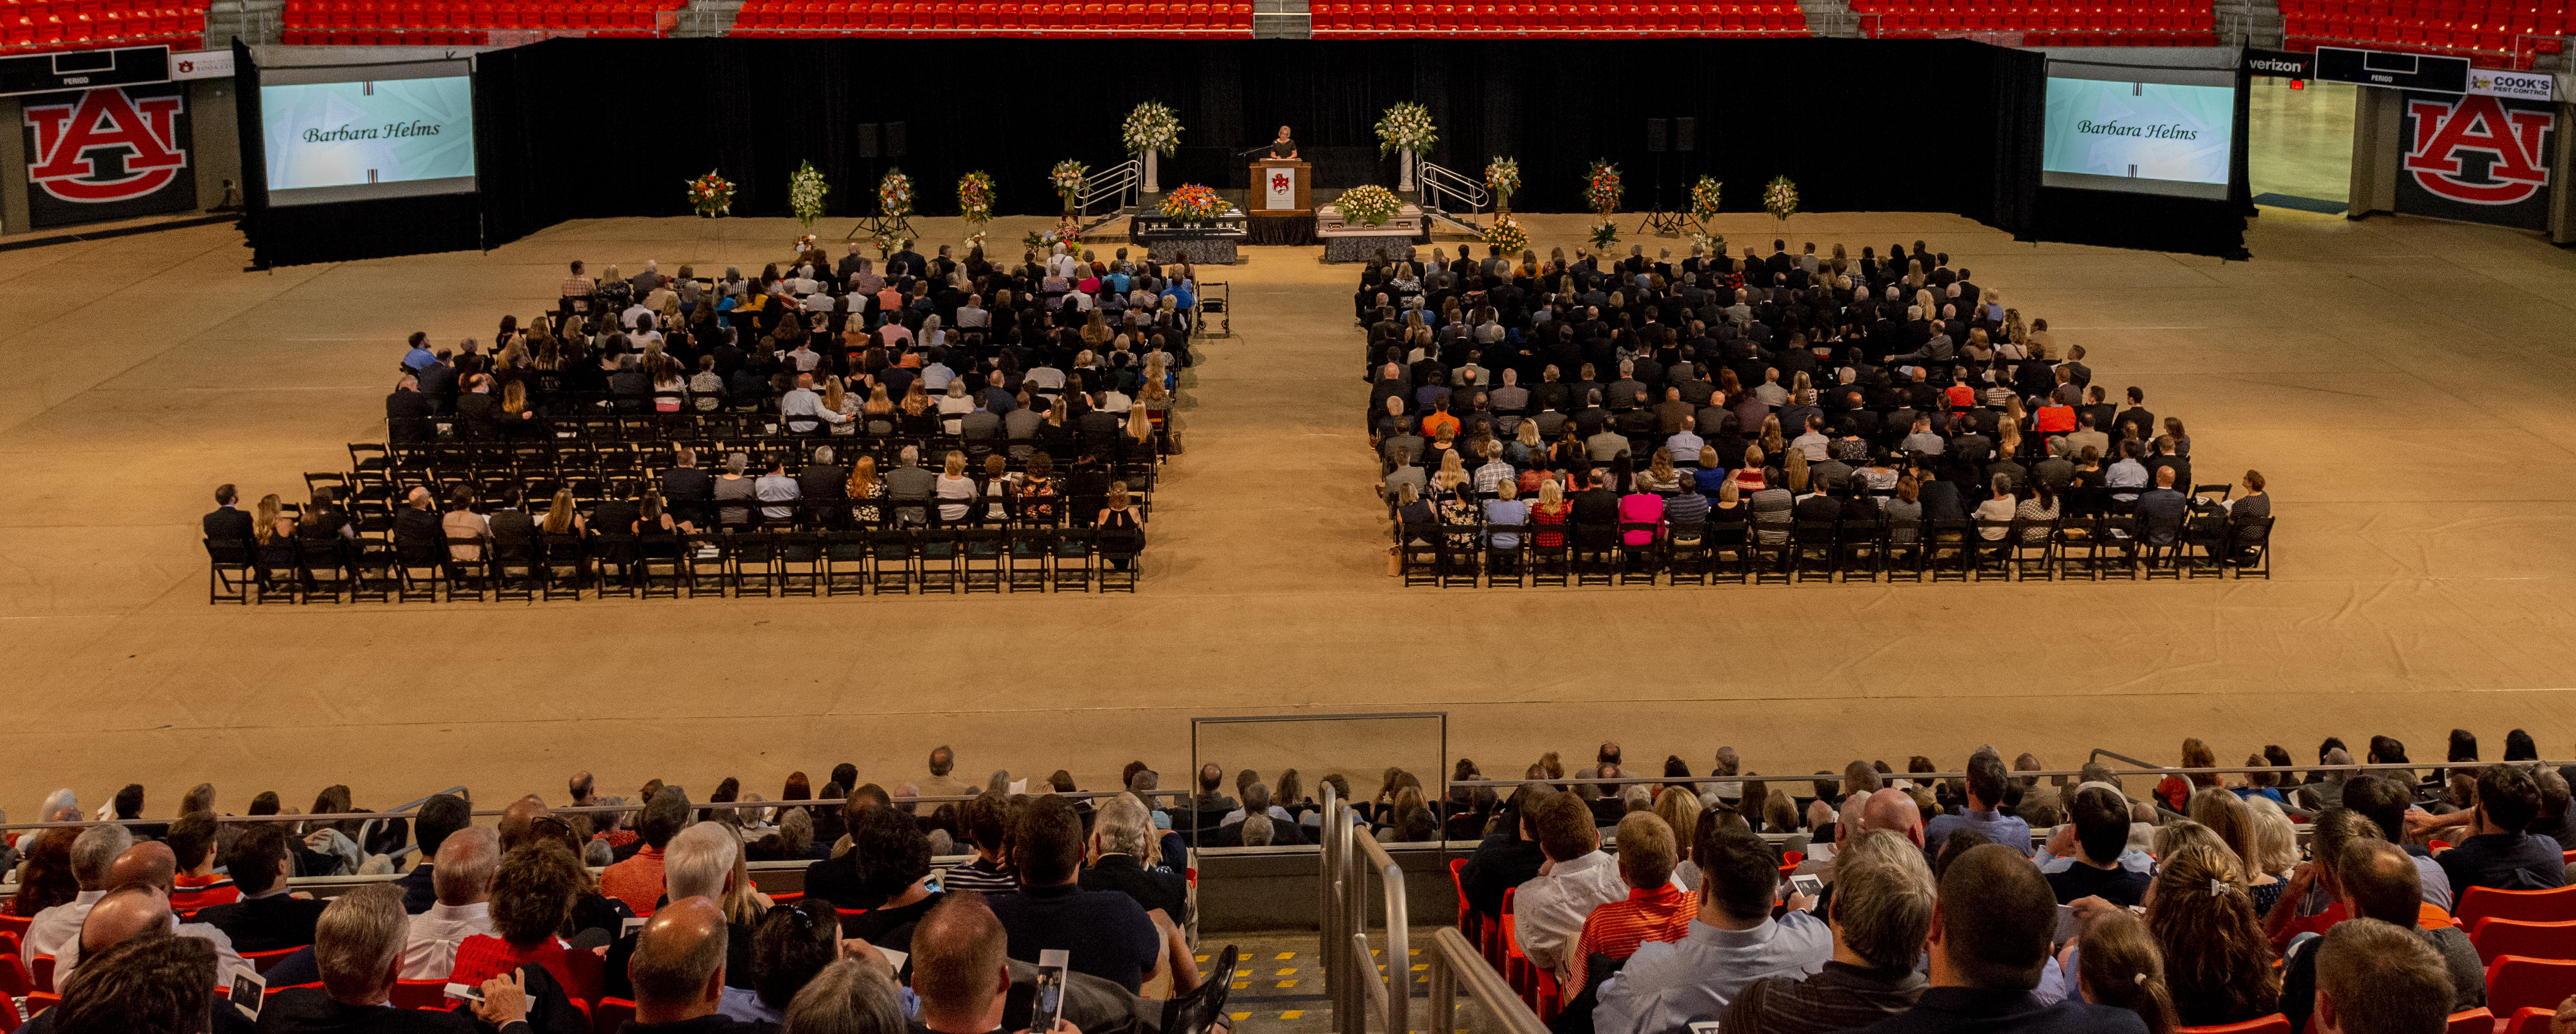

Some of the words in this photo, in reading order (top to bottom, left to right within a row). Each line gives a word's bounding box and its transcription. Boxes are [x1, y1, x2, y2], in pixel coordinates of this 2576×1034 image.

[2249, 58, 2301, 73] verizon
[63, 76, 89, 85] PERIOD
[2494, 76, 2550, 90] COOK'S
[2513, 87, 2548, 96] CONTROL
[303, 124, 377, 143] Barbara
[382, 120, 441, 139] Helms
[2077, 119, 2141, 137] Barbara
[2145, 124, 2197, 140] Helms
